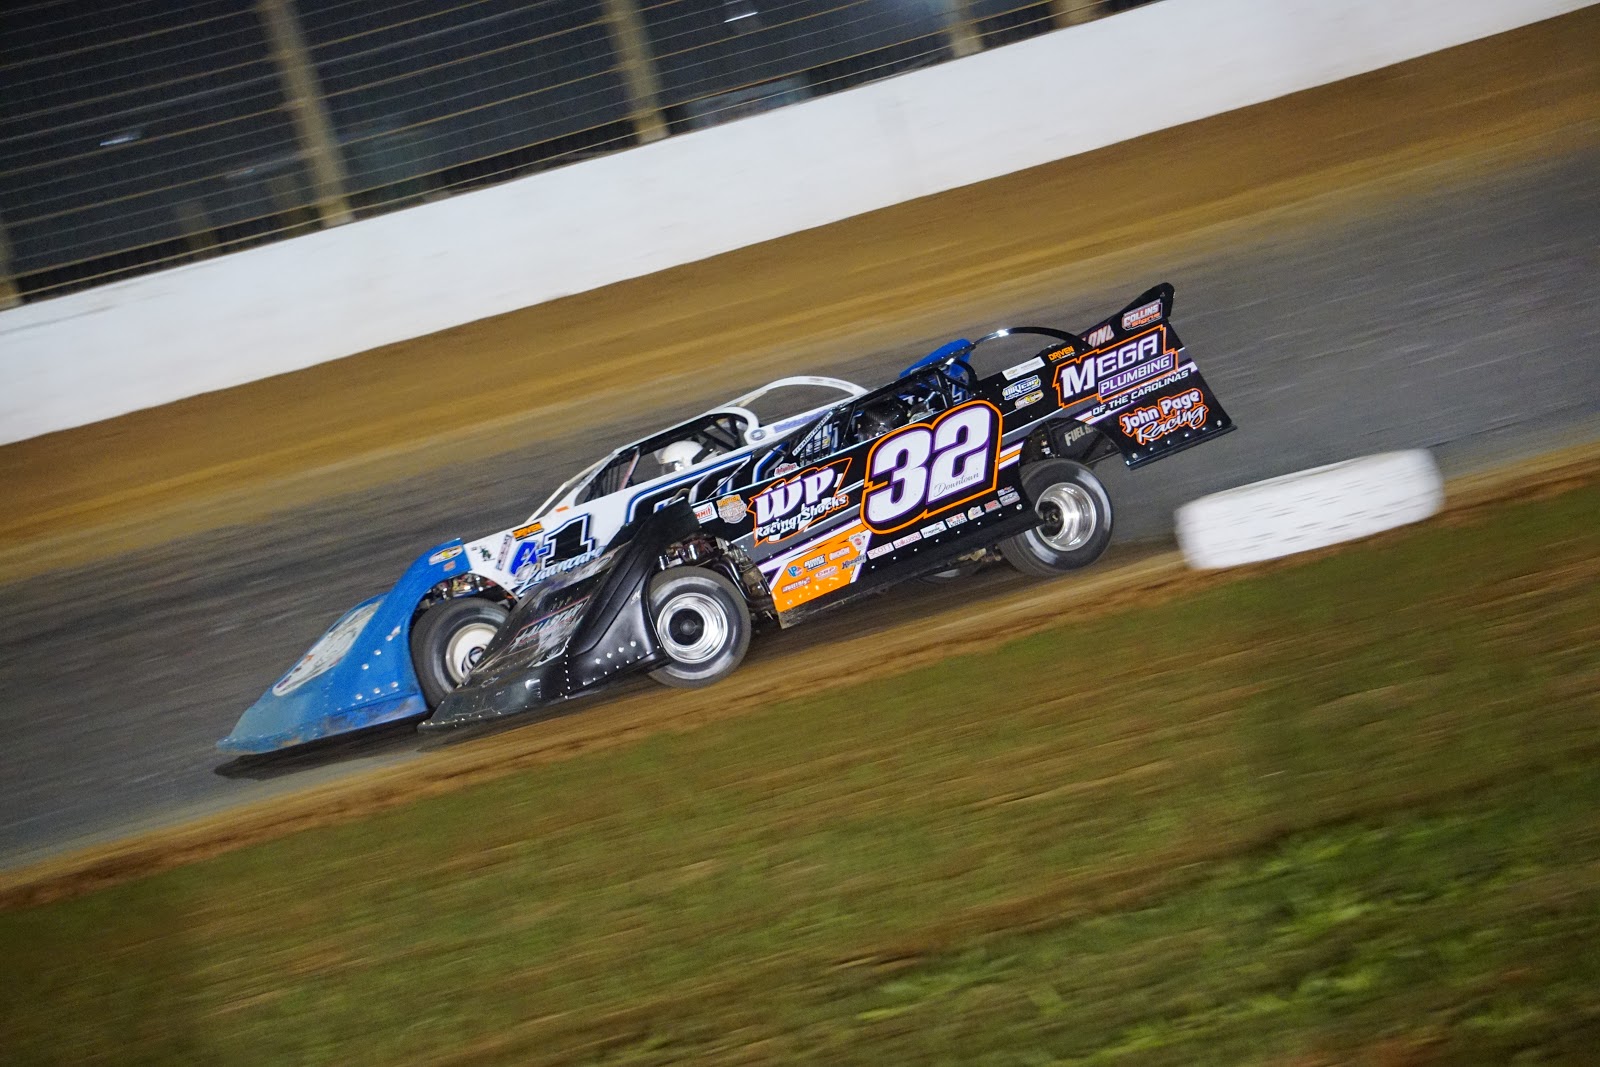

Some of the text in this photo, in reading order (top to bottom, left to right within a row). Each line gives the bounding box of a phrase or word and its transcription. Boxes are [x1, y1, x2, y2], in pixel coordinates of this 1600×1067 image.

[1123, 304, 1160, 327] COLLINS
[1048, 345, 1075, 361] DRIVEN
[1060, 332, 1159, 400] MEGA
[1093, 369, 1189, 416] OF THE CAROLINAS
[1100, 356, 1170, 393] PLUMBING
[1121, 390, 1200, 434] John Page
[1137, 405, 1207, 444] Racing
[1064, 426, 1087, 447] FUEL
[865, 404, 992, 525] 32
[933, 471, 979, 497] Downtown
[754, 467, 835, 526] WP
[755, 495, 847, 538] Racing Shocks
[868, 543, 892, 557] SCOTT
